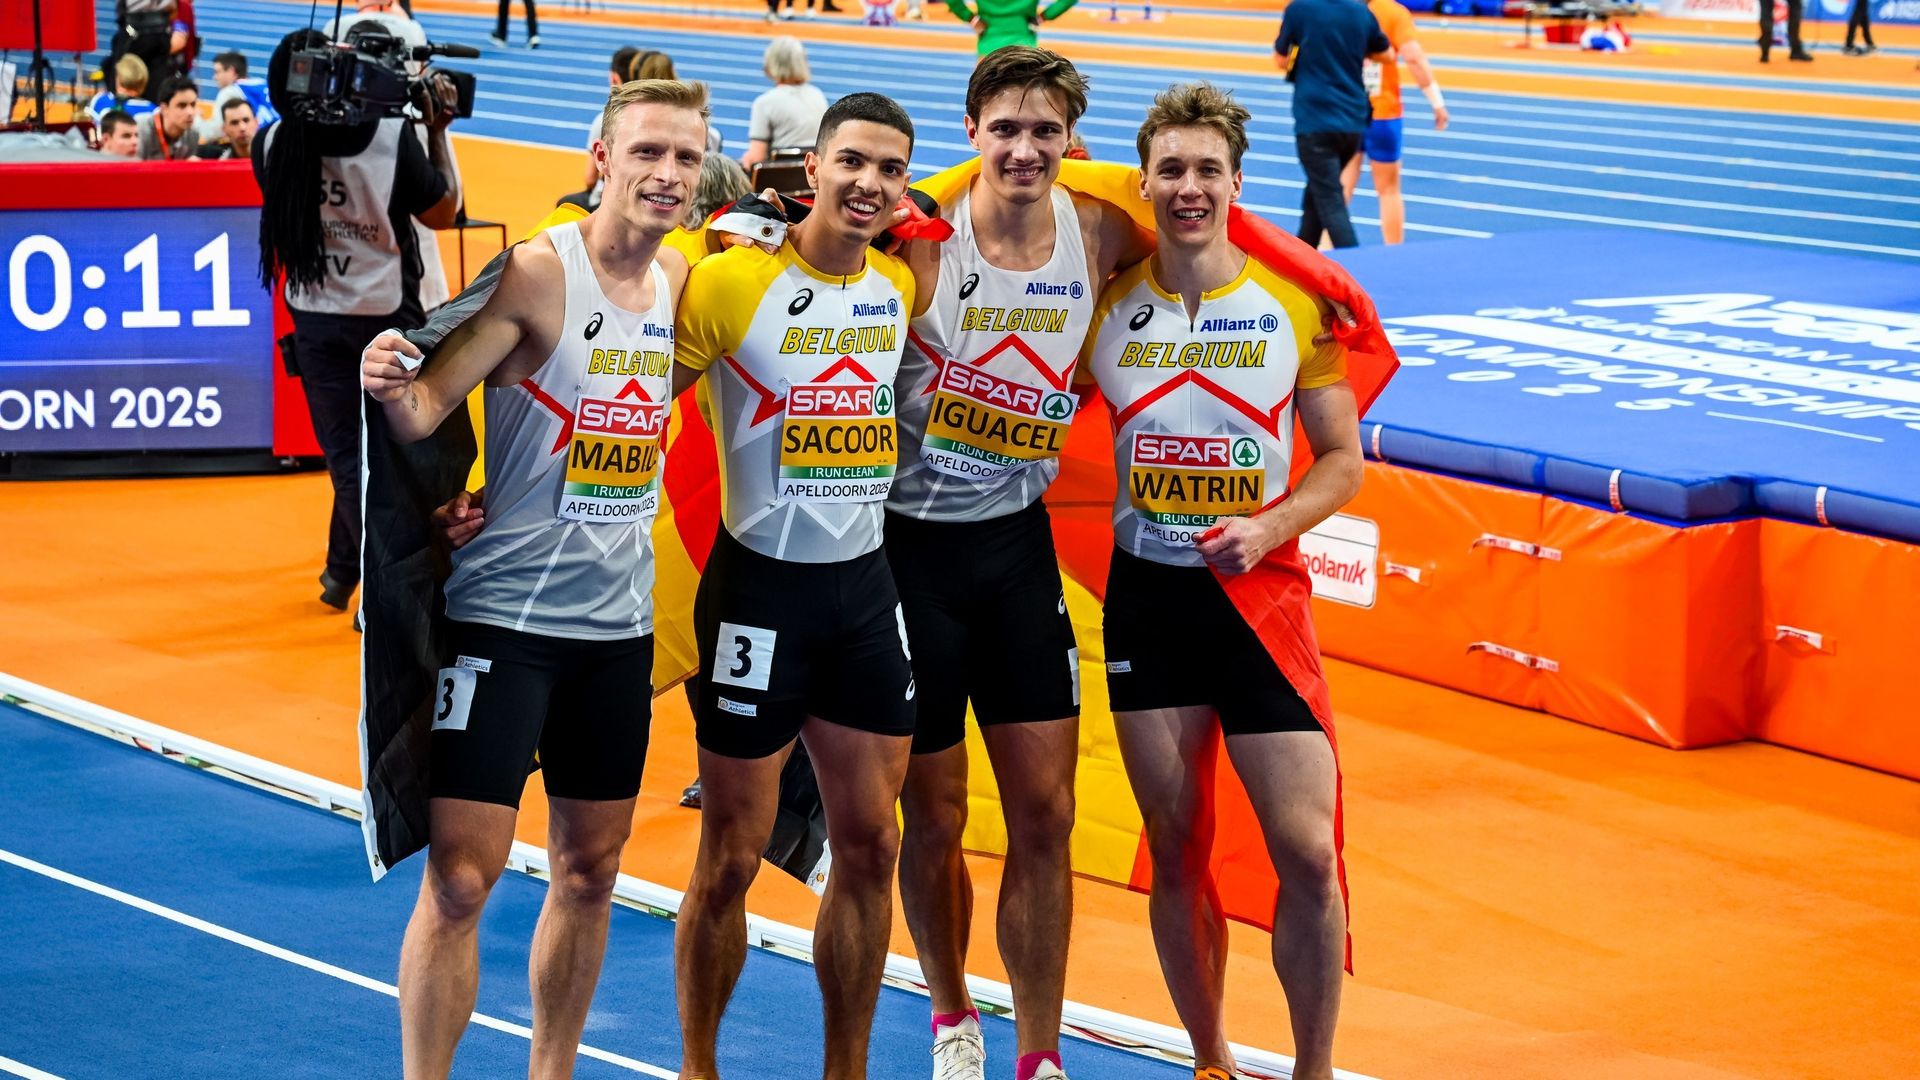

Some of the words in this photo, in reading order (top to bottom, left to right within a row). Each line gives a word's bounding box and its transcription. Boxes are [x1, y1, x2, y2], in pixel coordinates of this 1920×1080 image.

[1025, 281, 1067, 296] Allianz
[852, 302, 887, 318] Allianz
[961, 306, 1069, 334] BELGIUM
[779, 324, 896, 355] BELGIUM
[1200, 318, 1256, 333] Allianz
[1118, 340, 1267, 369] BELGIUM
[792, 389, 872, 412] SPAR
[947, 365, 1039, 411] SPAR
[109, 386, 223, 429] 2025
[933, 397, 1060, 452] IGUACEL
[784, 424, 894, 454] SACOOR
[958, 442, 985, 459] RUN
[1137, 438, 1228, 463] SPAR
[571, 439, 659, 473] MABIL
[816, 467, 841, 478] RUN
[593, 485, 598, 496] I
[599, 485, 625, 498] RUN
[784, 484, 868, 498] APELDOORN
[869, 481, 890, 496] 2025
[1132, 471, 1259, 503] WATRIN
[1162, 513, 1190, 524] RUN
[729, 635, 752, 678] 3
[437, 677, 455, 722] 3
